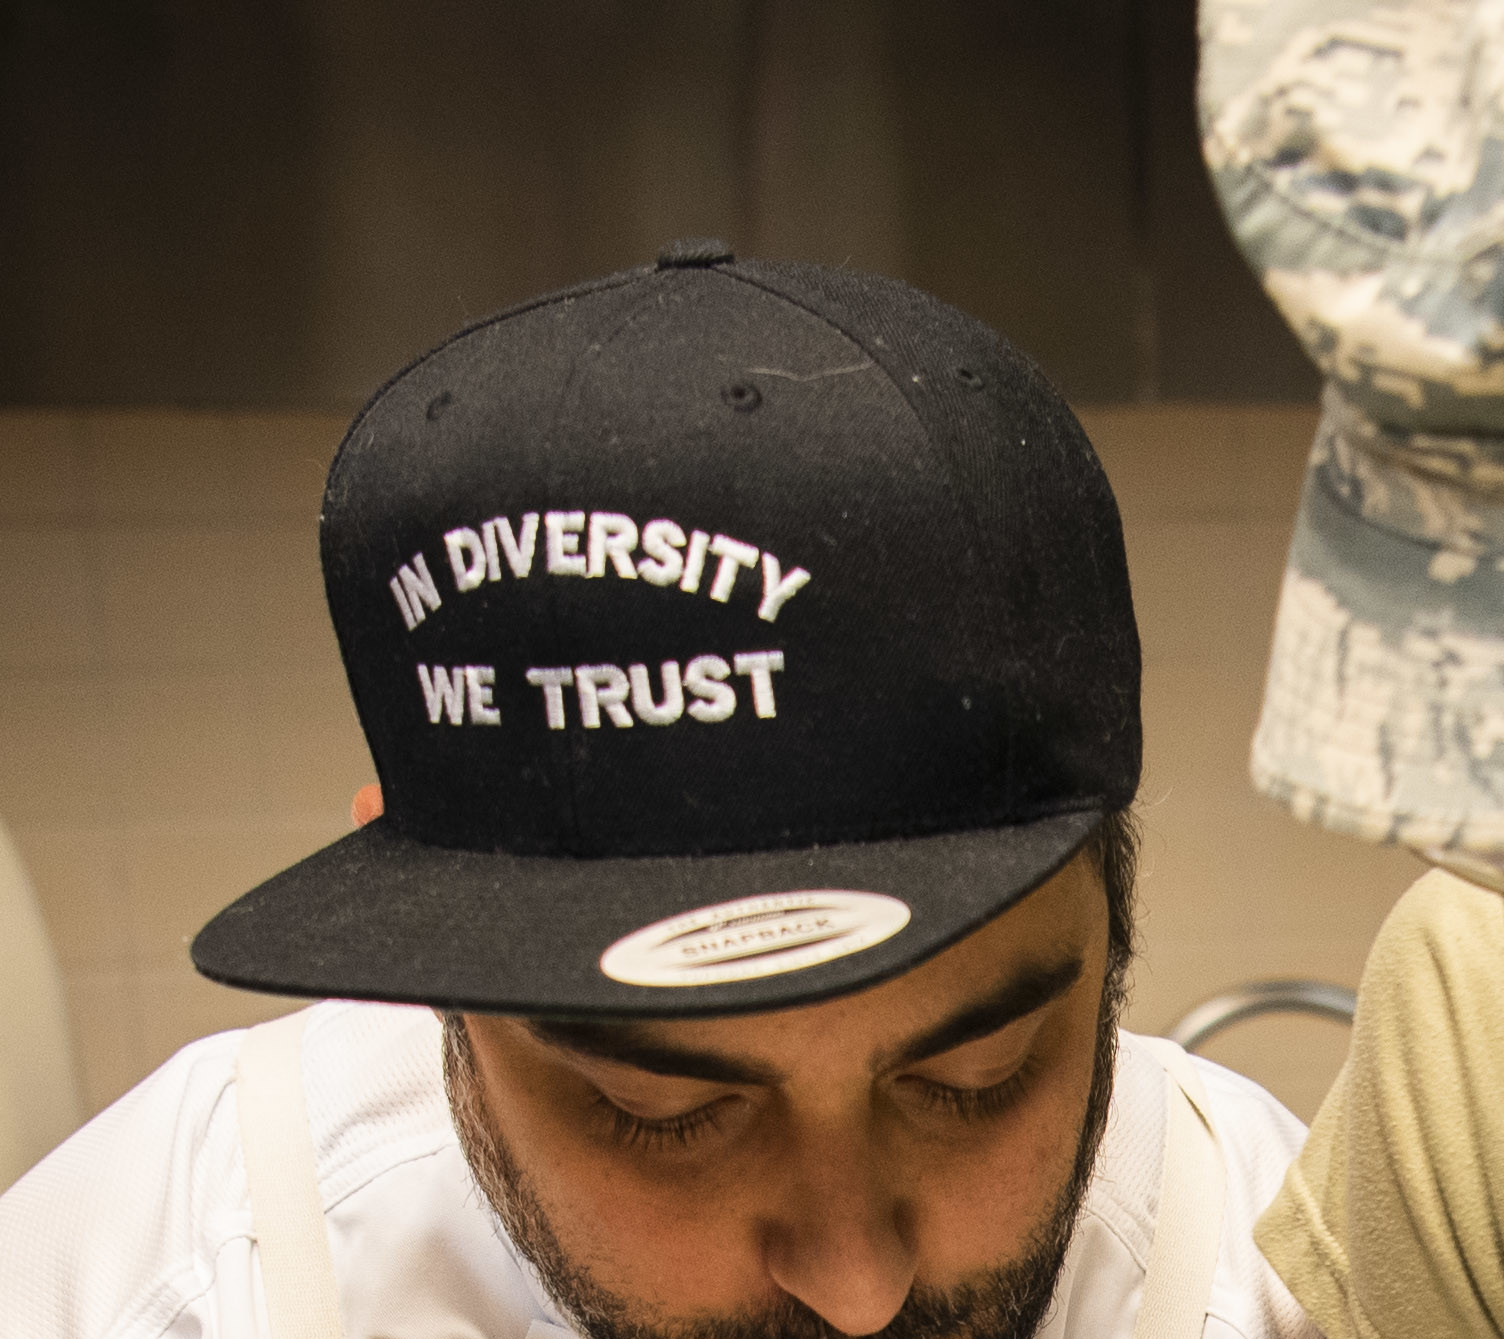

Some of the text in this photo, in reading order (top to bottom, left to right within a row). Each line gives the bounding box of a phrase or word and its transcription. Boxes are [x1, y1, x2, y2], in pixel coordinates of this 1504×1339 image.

[390, 511, 811, 632] IN DIVERSITY
[417, 650, 785, 730] WE TRUST
